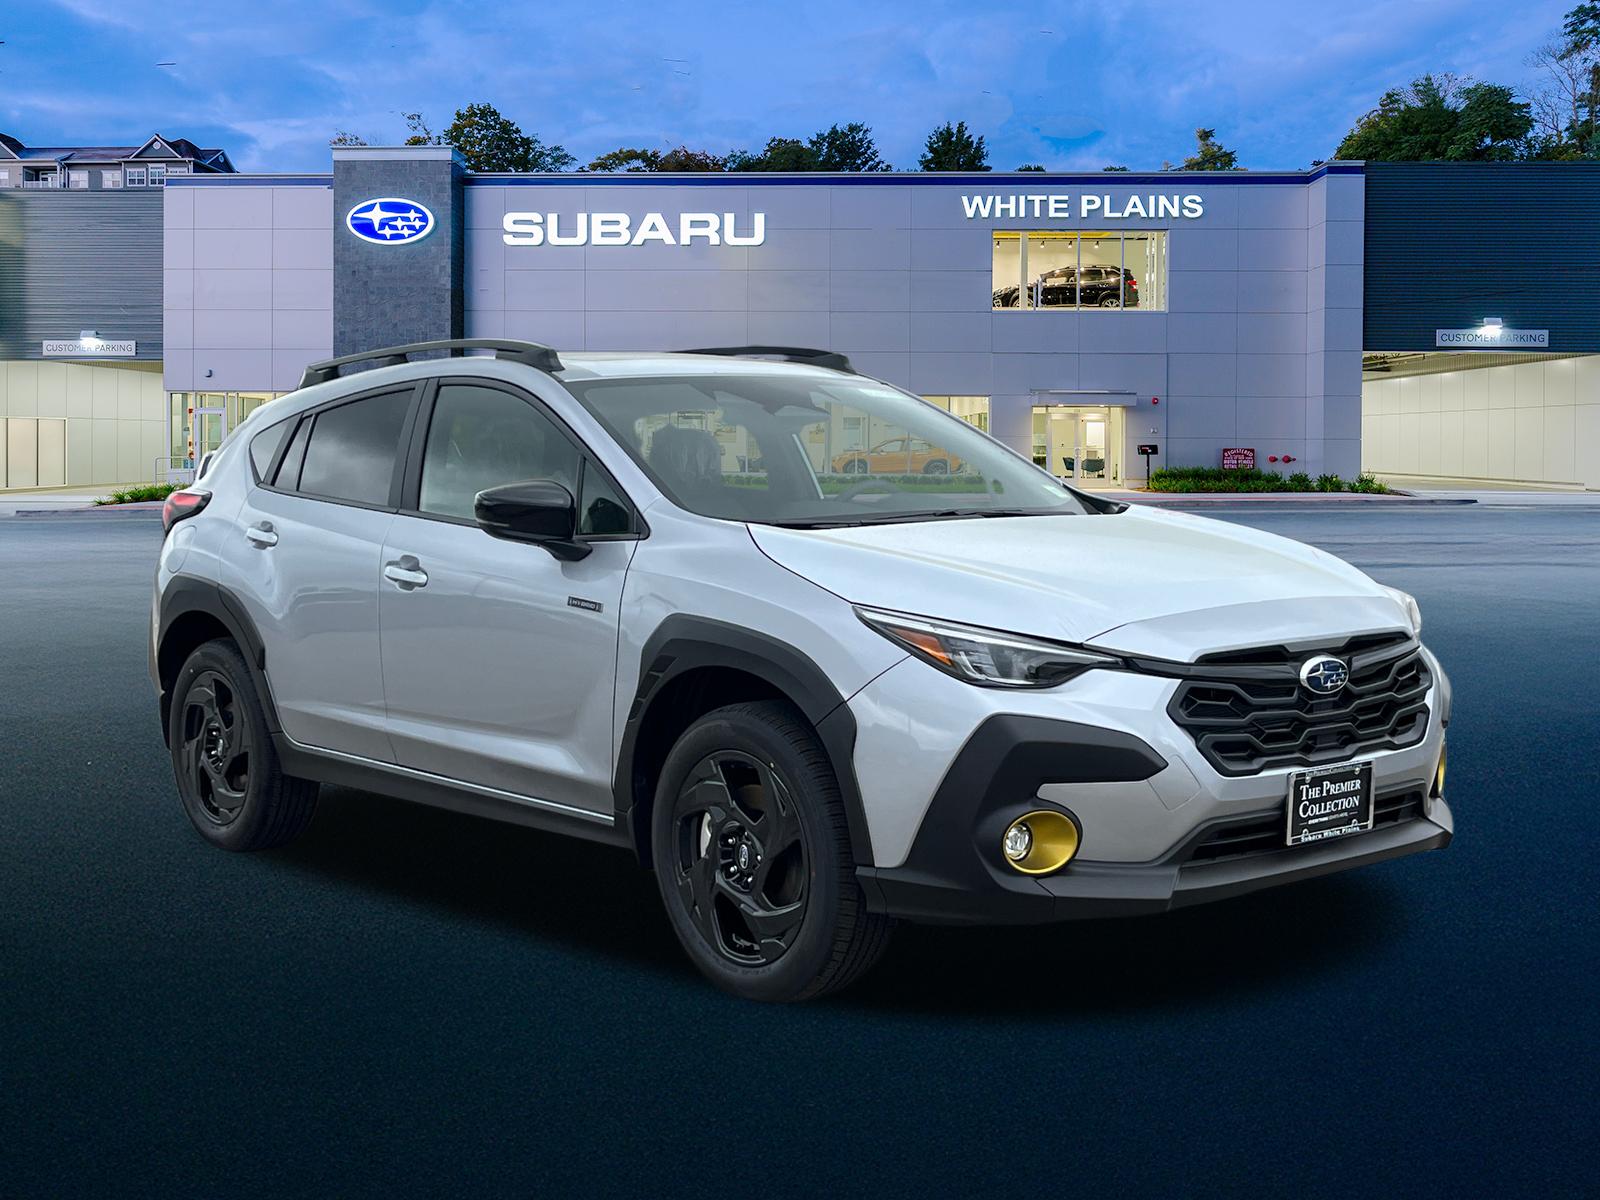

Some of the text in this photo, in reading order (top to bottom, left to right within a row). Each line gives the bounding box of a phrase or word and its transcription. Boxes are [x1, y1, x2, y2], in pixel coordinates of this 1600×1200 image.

[961, 194, 1204, 219] WHITE PLAINS
[502, 212, 766, 247] SUBARU
[94, 343, 133, 352] PARKING
[1500, 333, 1546, 343] PARKING
[1299, 779, 1361, 800] THE PREMIER
[1299, 795, 1360, 818] COLLECTION
